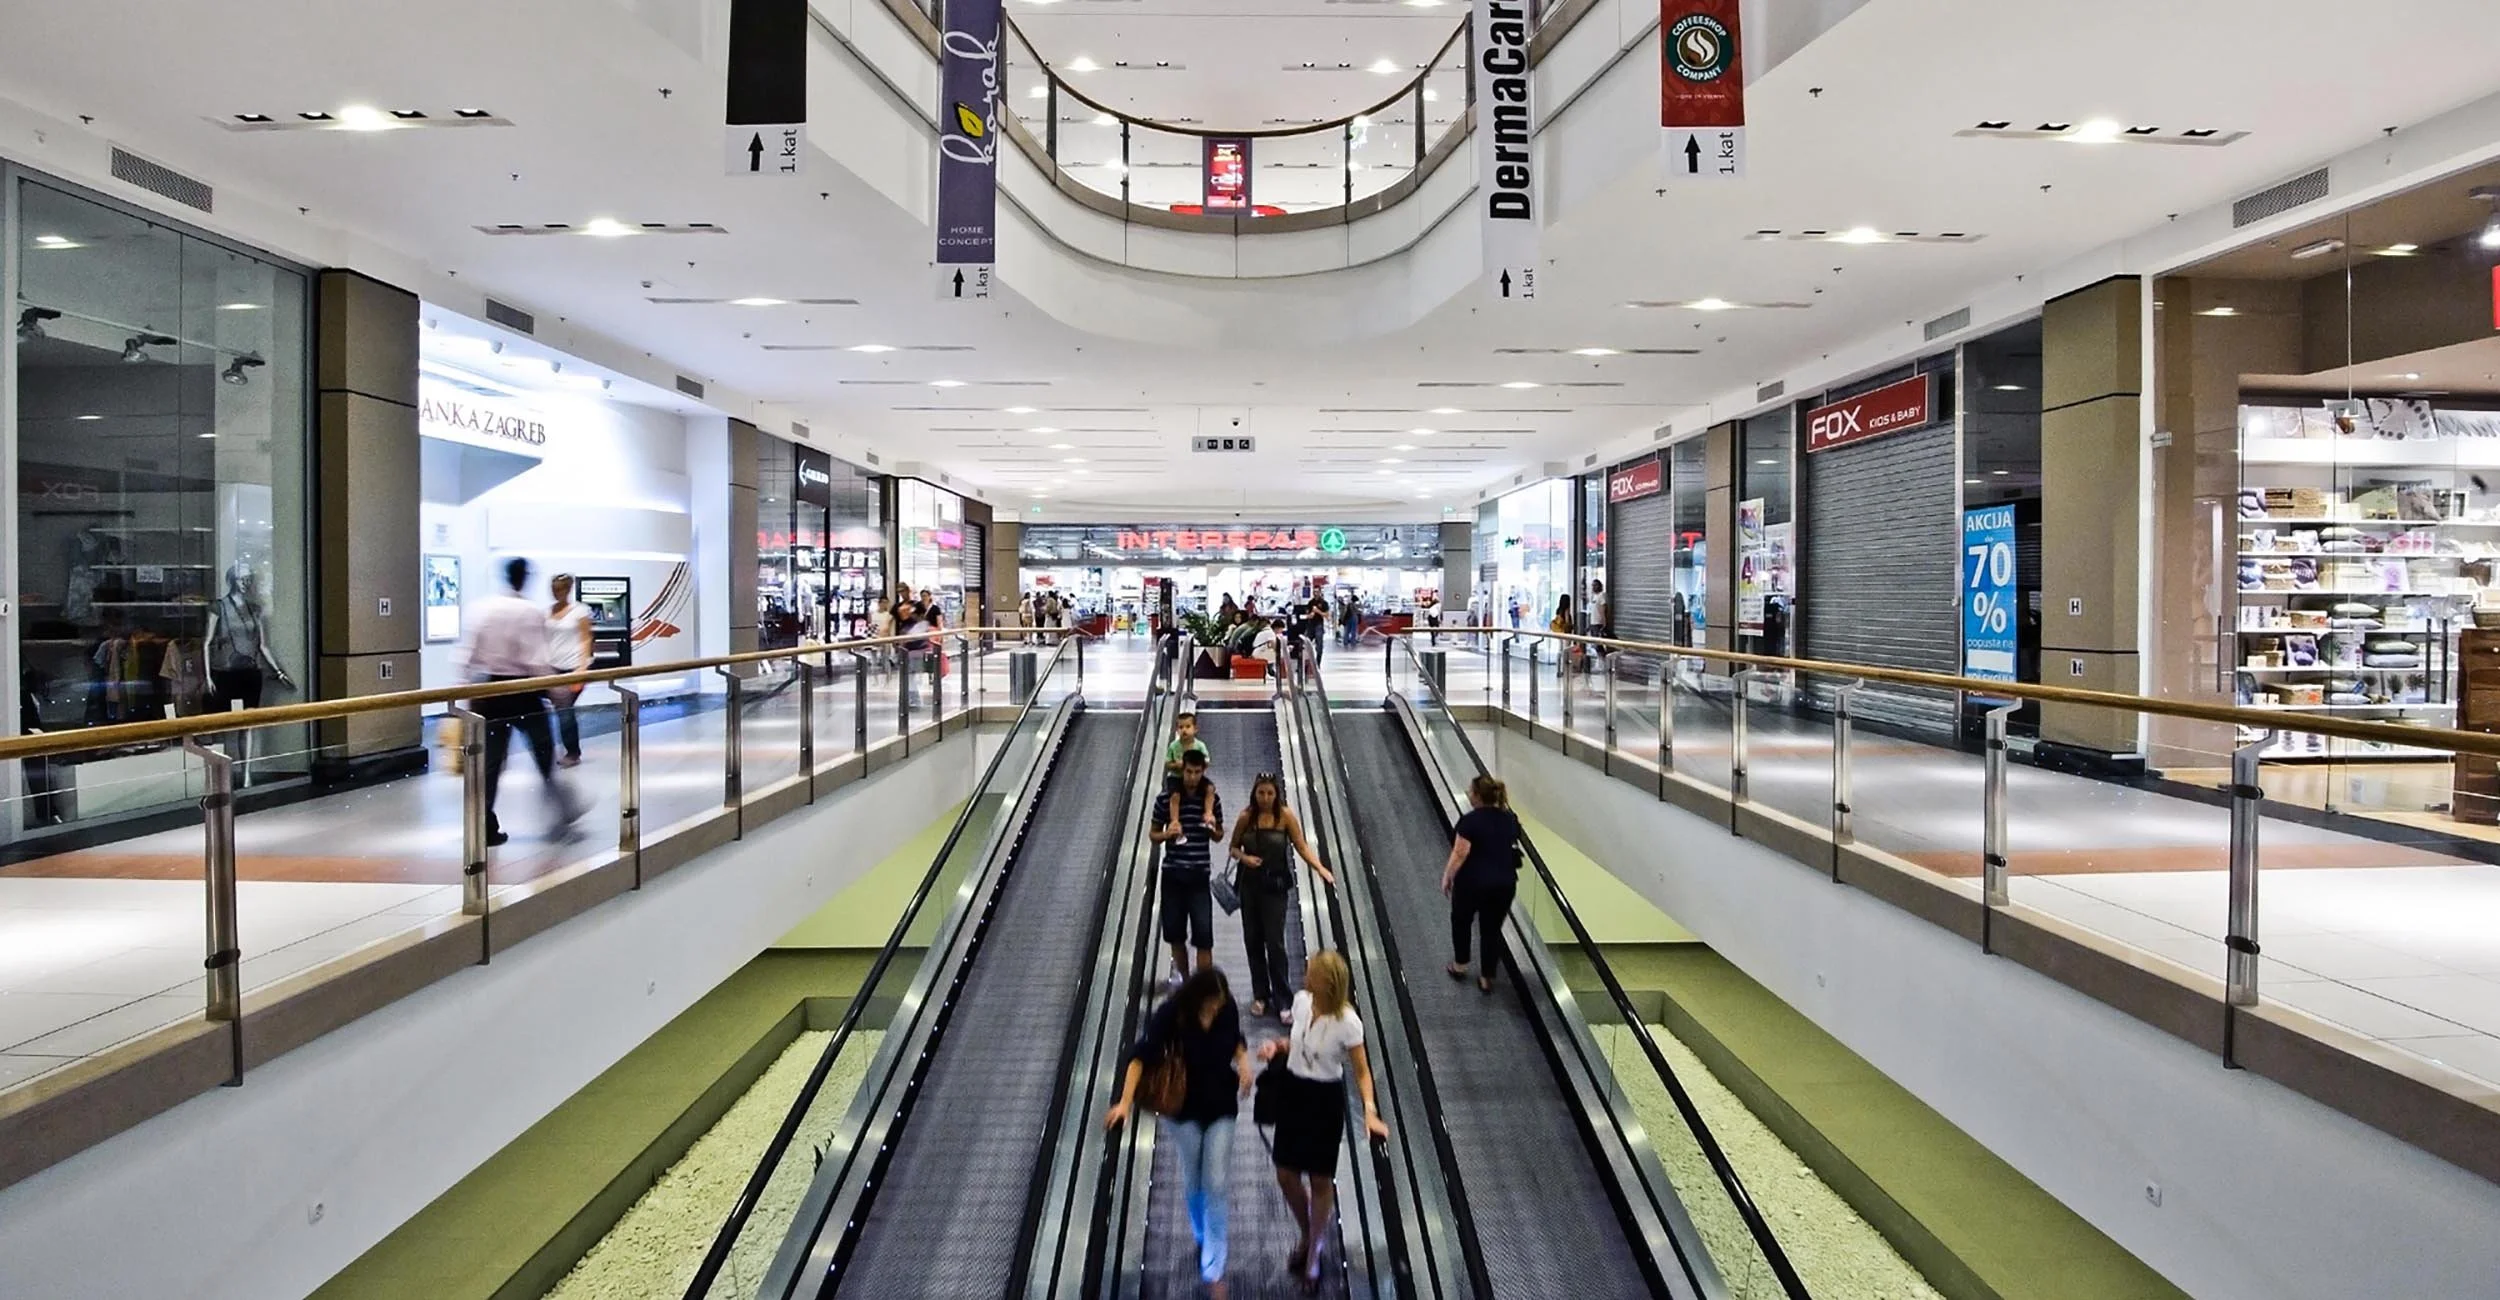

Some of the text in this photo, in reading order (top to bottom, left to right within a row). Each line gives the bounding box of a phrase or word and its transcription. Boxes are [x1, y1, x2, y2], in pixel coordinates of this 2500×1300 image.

[1672, 15, 1727, 36] COFFEESHOP
[1676, 64, 1722, 80] COMPANY
[942, 22, 999, 164] korak
[1482, 0, 1531, 220] DermaCar
[780, 129, 797, 173] 1.kat
[1718, 131, 1735, 174] 1.kat
[938, 237, 993, 246] CONCEPT
[950, 226, 985, 234] HOME
[975, 267, 989, 299] 1.kat
[1522, 267, 1534, 299] 1.kat
[418, 397, 546, 446] ANKA ZAGREB
[1811, 405, 1862, 445] FOX
[1869, 414, 1890, 428] KIDS
[1896, 405, 1921, 421] BABY
[1611, 474, 1634, 498] FOX
[1966, 510, 2012, 532] AKCIJA
[1118, 530, 1318, 550] INTERSPAR
[1968, 541, 2011, 588] 70
[380, 601, 389, 613] H
[1973, 591, 2006, 633] %
[2071, 600, 2080, 613] H
[1967, 638, 2014, 649] popusta na
